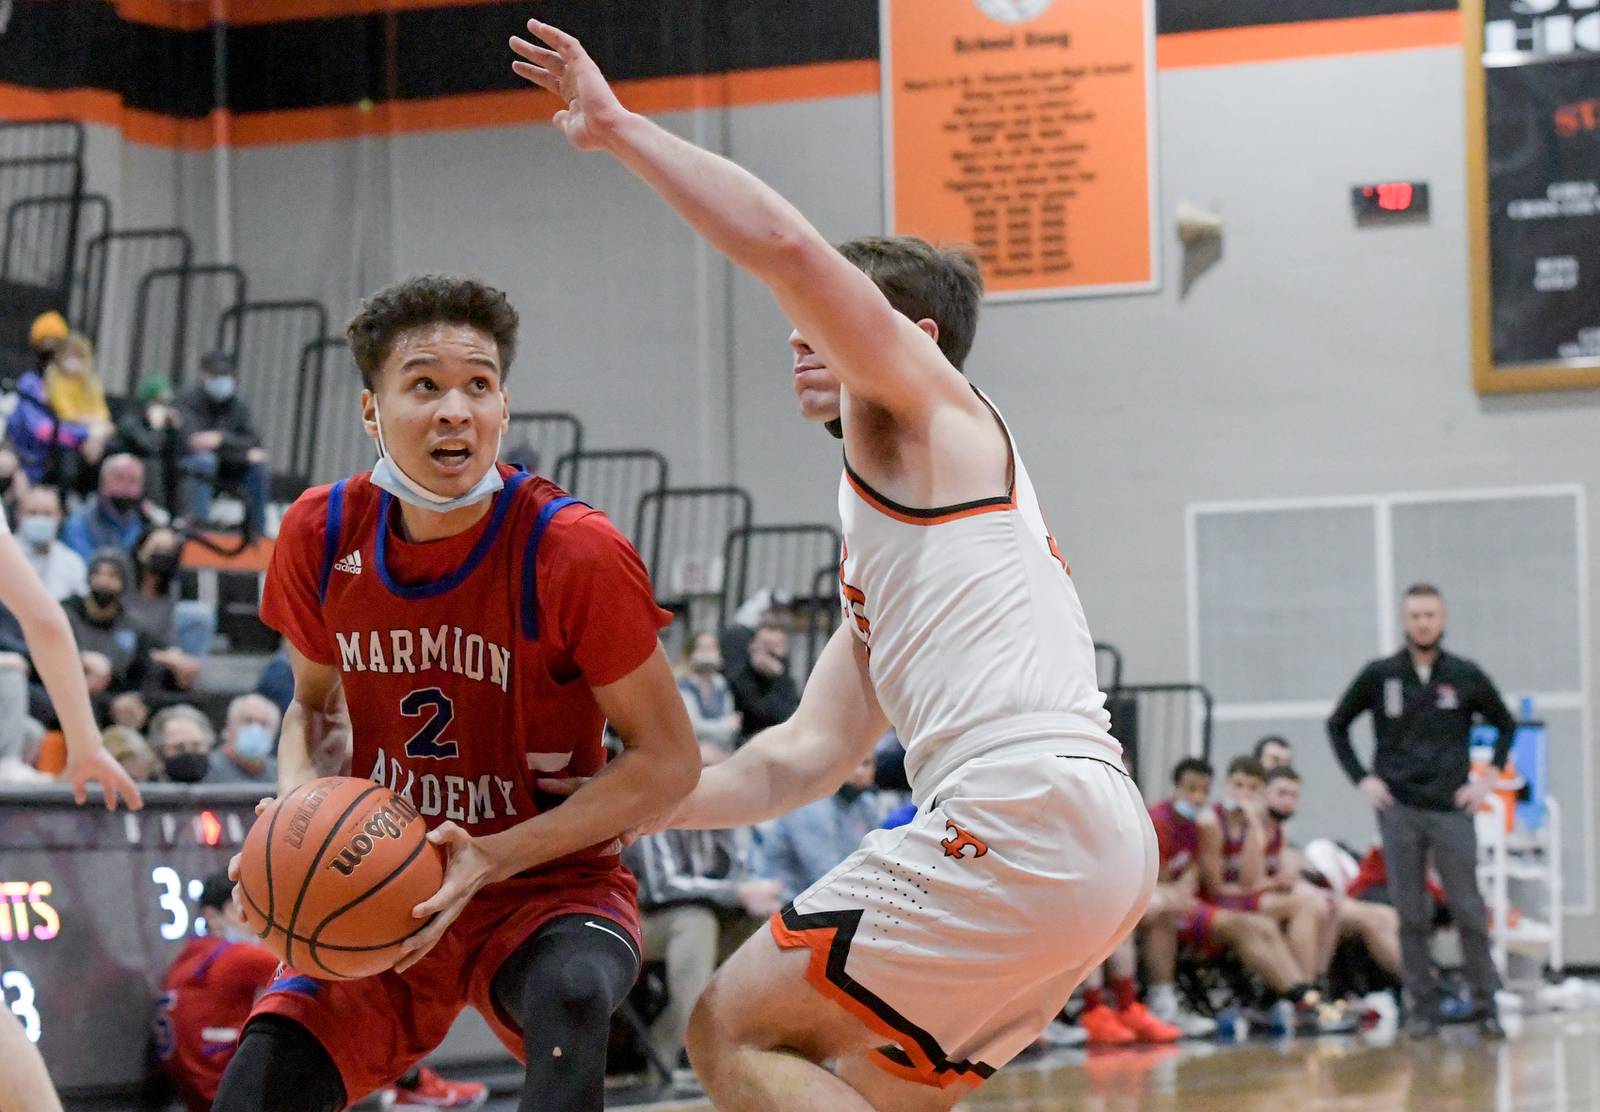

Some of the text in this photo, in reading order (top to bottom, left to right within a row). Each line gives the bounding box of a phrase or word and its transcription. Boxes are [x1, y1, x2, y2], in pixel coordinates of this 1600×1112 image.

[335, 624, 511, 693] MARMION
[399, 686, 459, 761] 2
[369, 746, 518, 825] ACADEMY
